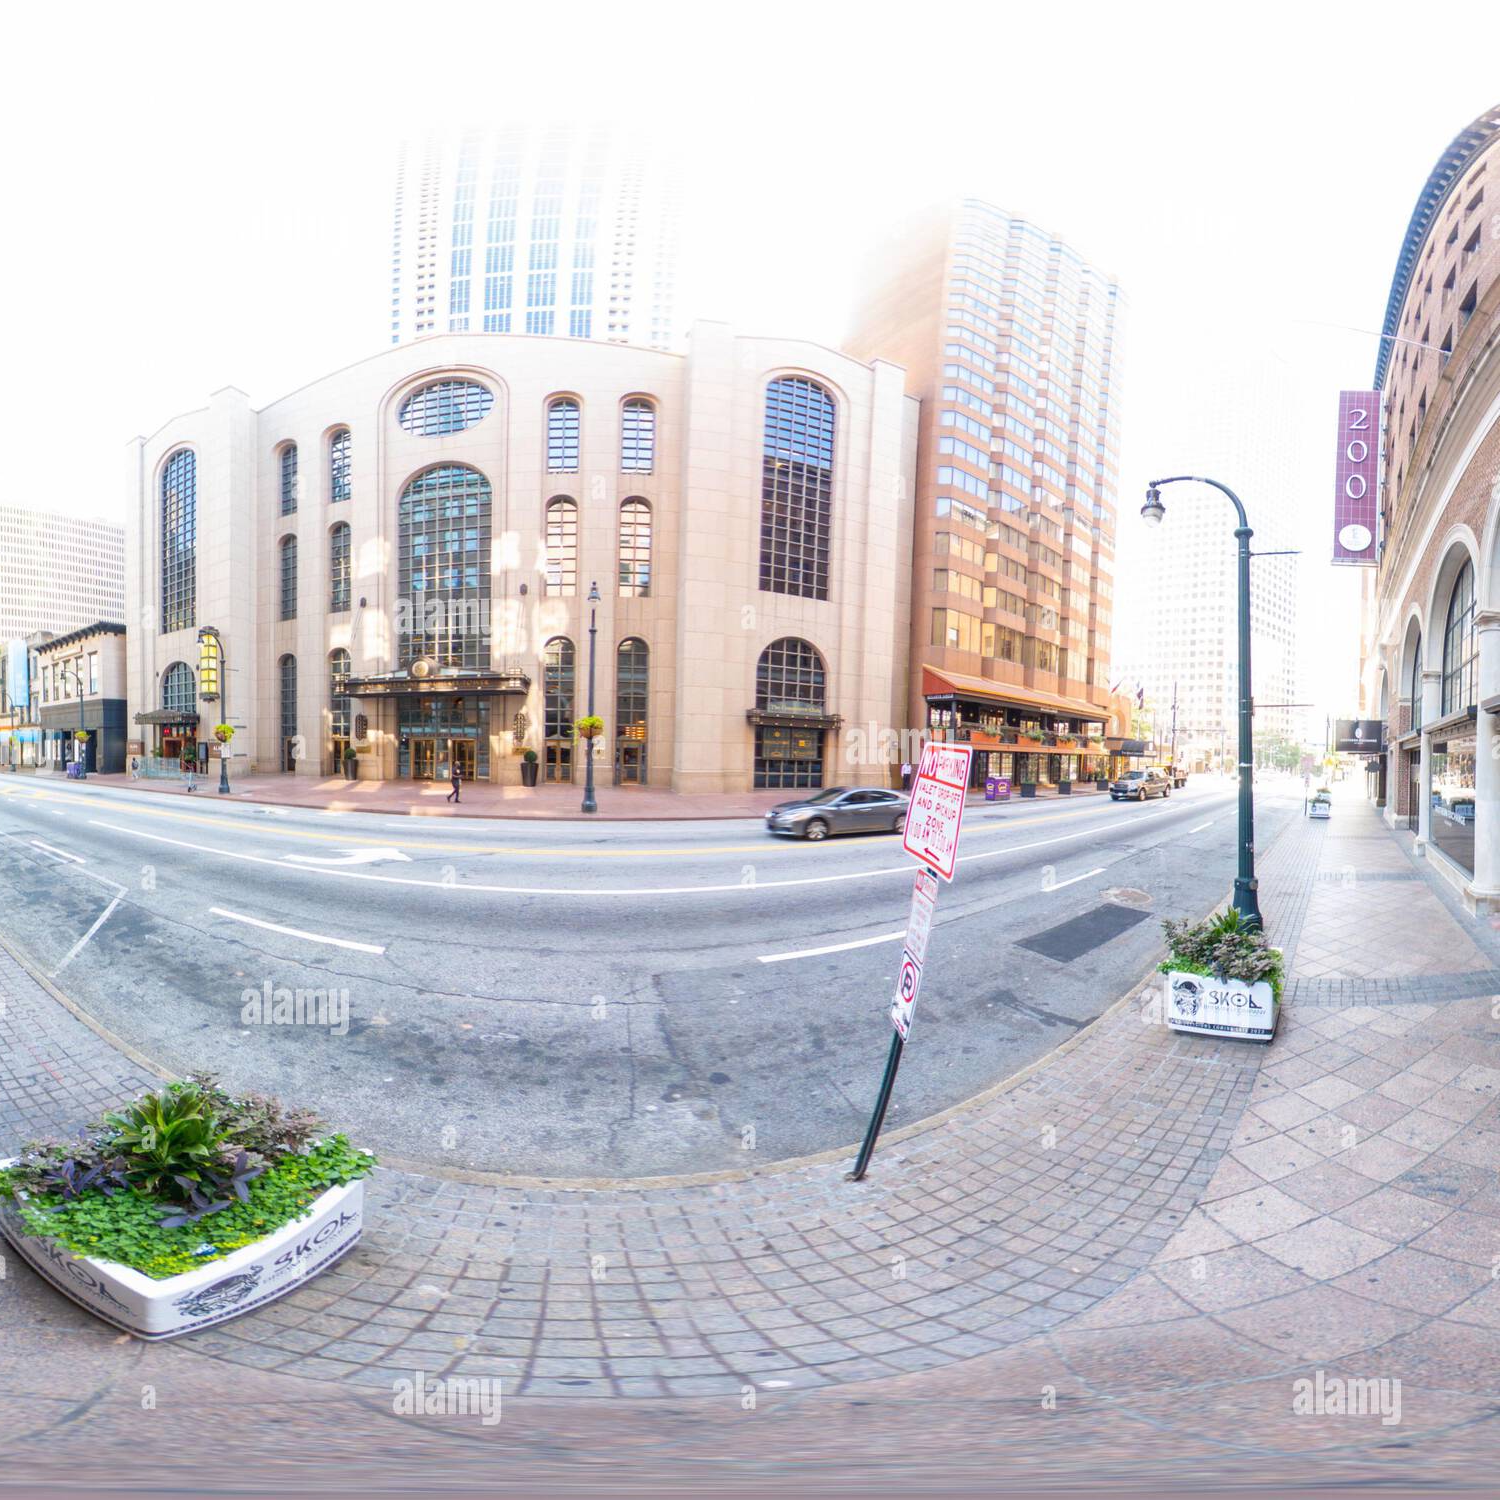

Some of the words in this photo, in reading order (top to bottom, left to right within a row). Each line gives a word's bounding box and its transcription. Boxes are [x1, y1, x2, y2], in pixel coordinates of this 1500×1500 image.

[1345, 408, 1370, 500] 200
[921, 750, 938, 778] NO
[916, 797, 933, 811] AND
[935, 802, 957, 822] PICKUP
[926, 815, 945, 831] ZONE
[1208, 990, 1263, 1009] SKOL
[274, 1211, 357, 1273] SKOL
